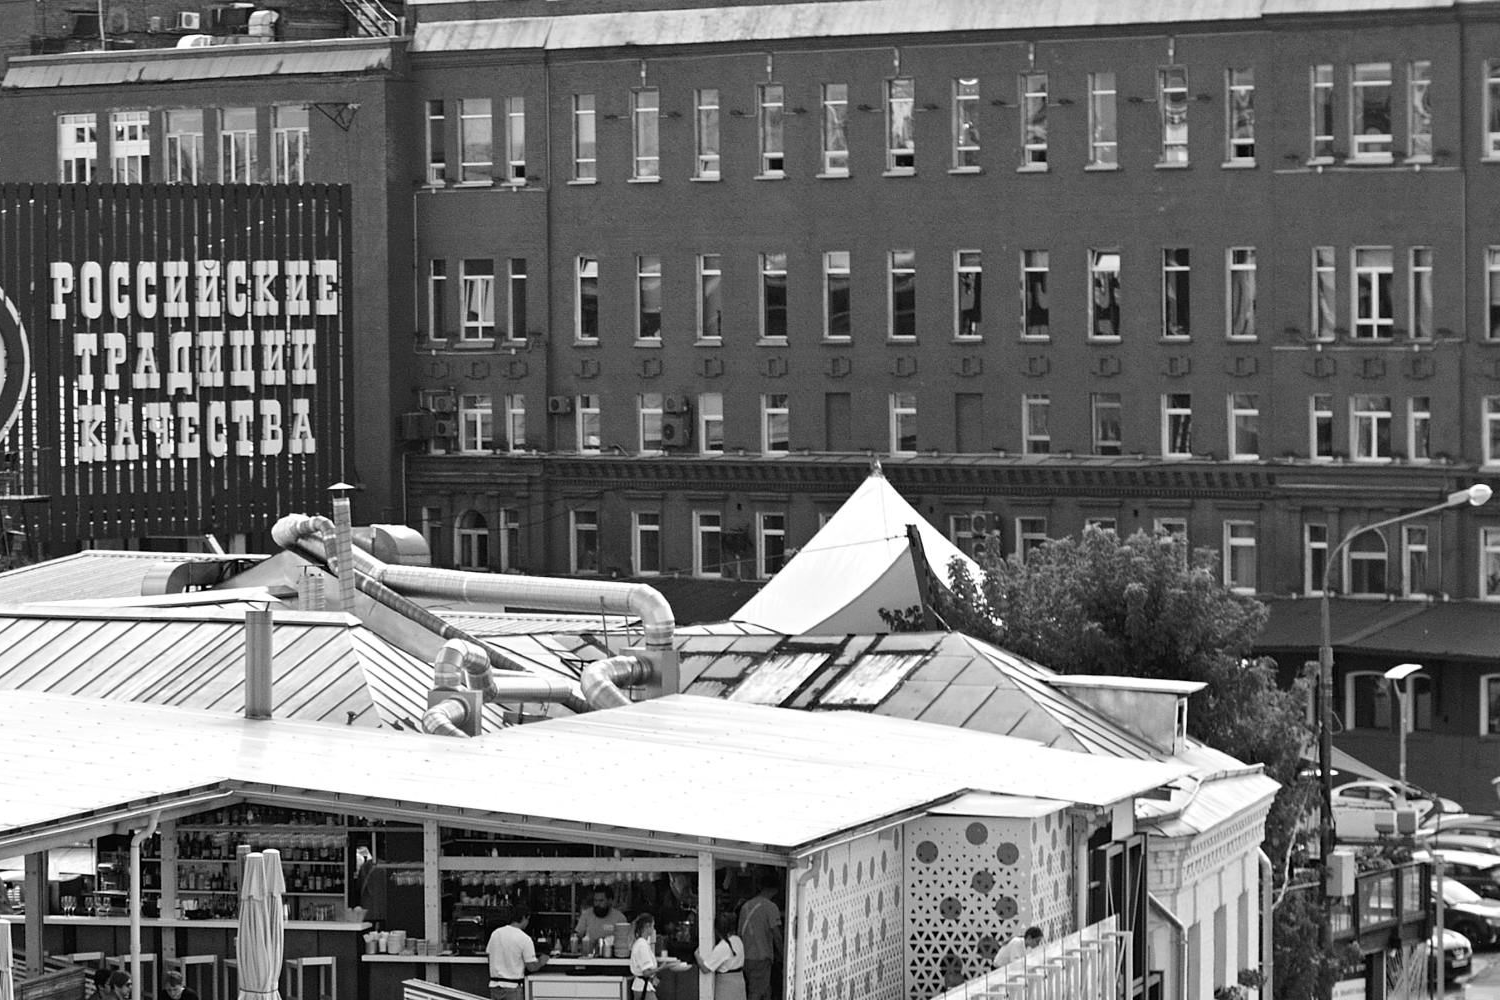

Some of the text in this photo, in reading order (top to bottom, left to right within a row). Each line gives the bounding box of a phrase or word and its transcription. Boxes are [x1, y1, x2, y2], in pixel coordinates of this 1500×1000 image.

[50, 259, 338, 319] РОССИЙСКИЕ
[74, 329, 316, 394] ТРАДИЦИИ
[78, 398, 316, 461] КАЧЕСТВА
